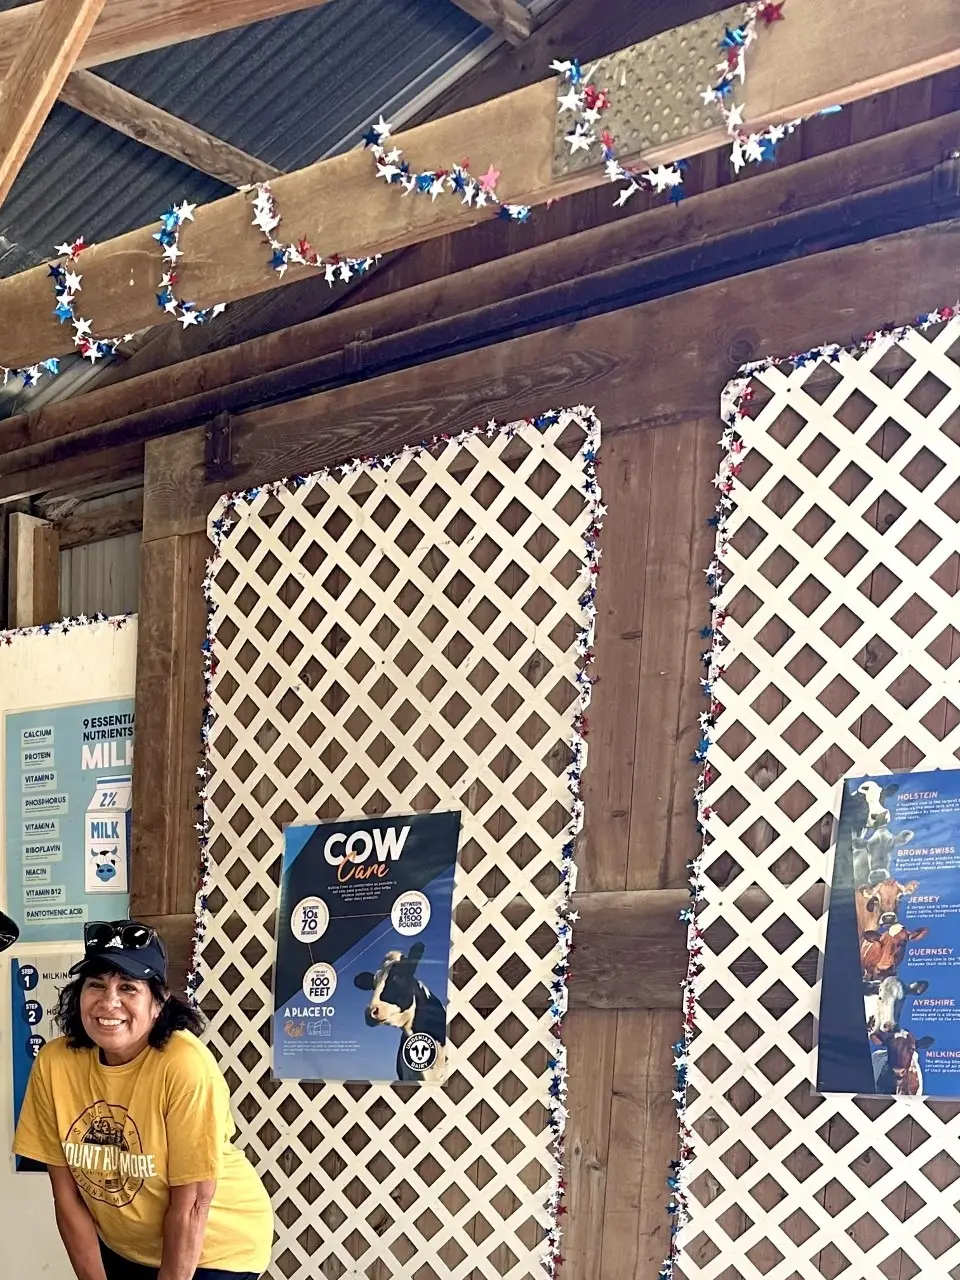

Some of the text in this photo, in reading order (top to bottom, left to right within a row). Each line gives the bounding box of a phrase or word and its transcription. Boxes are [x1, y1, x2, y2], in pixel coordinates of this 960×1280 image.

[83, 713, 135, 729] 9 ESSENTI
[24, 729, 52, 738] CALCIUM
[83, 727, 134, 741] NUTRIENTS
[24, 752, 51, 761] PROTEIN
[25, 774, 49, 783] VITAMIN
[25, 796, 66, 806] PHOSPHORUS
[100, 792, 117, 807] 2%
[897, 791, 938, 801] HOLSTEIN
[25, 823, 50, 831] VITAMIN
[91, 821, 119, 839] MILK
[25, 844, 60, 854] RIBOFLAVIN
[323, 826, 411, 866] COW
[897, 846, 955, 856] BROWN SWISS
[337, 851, 389, 882] Care
[25, 868, 46, 876] NIACIN
[908, 895, 940, 904] JERSEY
[27, 909, 68, 917] PANTOTHENIC
[400, 907, 422, 916] 1200
[302, 919, 318, 931] 70
[908, 948, 954, 956] GUERNSEY
[24, 976, 30, 987] 1
[310, 977, 330, 987] 100
[310, 987, 330, 997] FEET
[29, 1011, 36, 1022] 2
[284, 1006, 335, 1018] A PLACE TO
[406, 1035, 435, 1050] UNDENIABLY
[32, 1045, 40, 1056] 3
[73, 1105, 102, 1135] SINC
